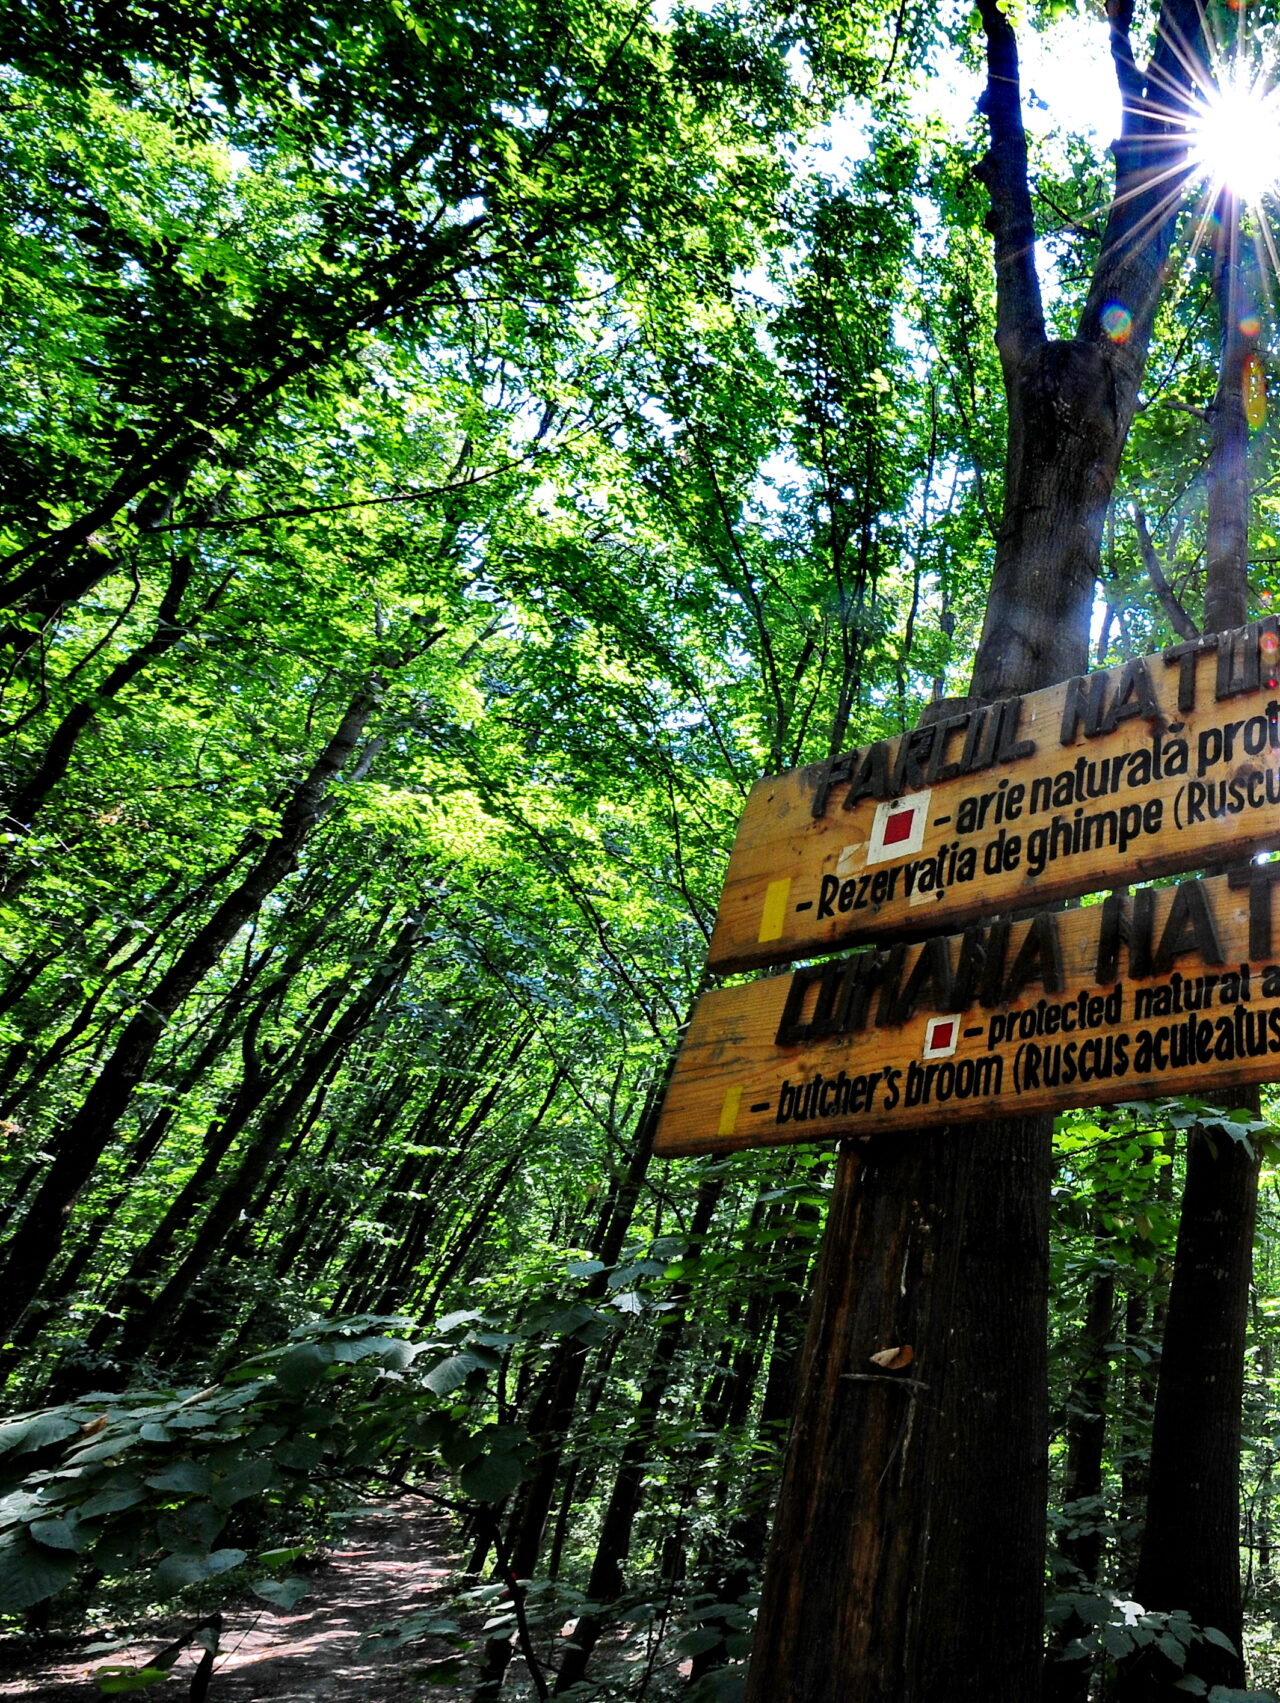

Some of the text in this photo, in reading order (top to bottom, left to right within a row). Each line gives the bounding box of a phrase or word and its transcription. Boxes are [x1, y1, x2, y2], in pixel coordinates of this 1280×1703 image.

[812, 698, 1036, 818] PARCUL
[983, 829, 1021, 875] de
[1026, 798, 1162, 877] ghimpe
[1134, 963, 1251, 1020] natural
[904, 1054, 1003, 1108] broom
[1013, 1033, 1129, 1094] (Ruscus
